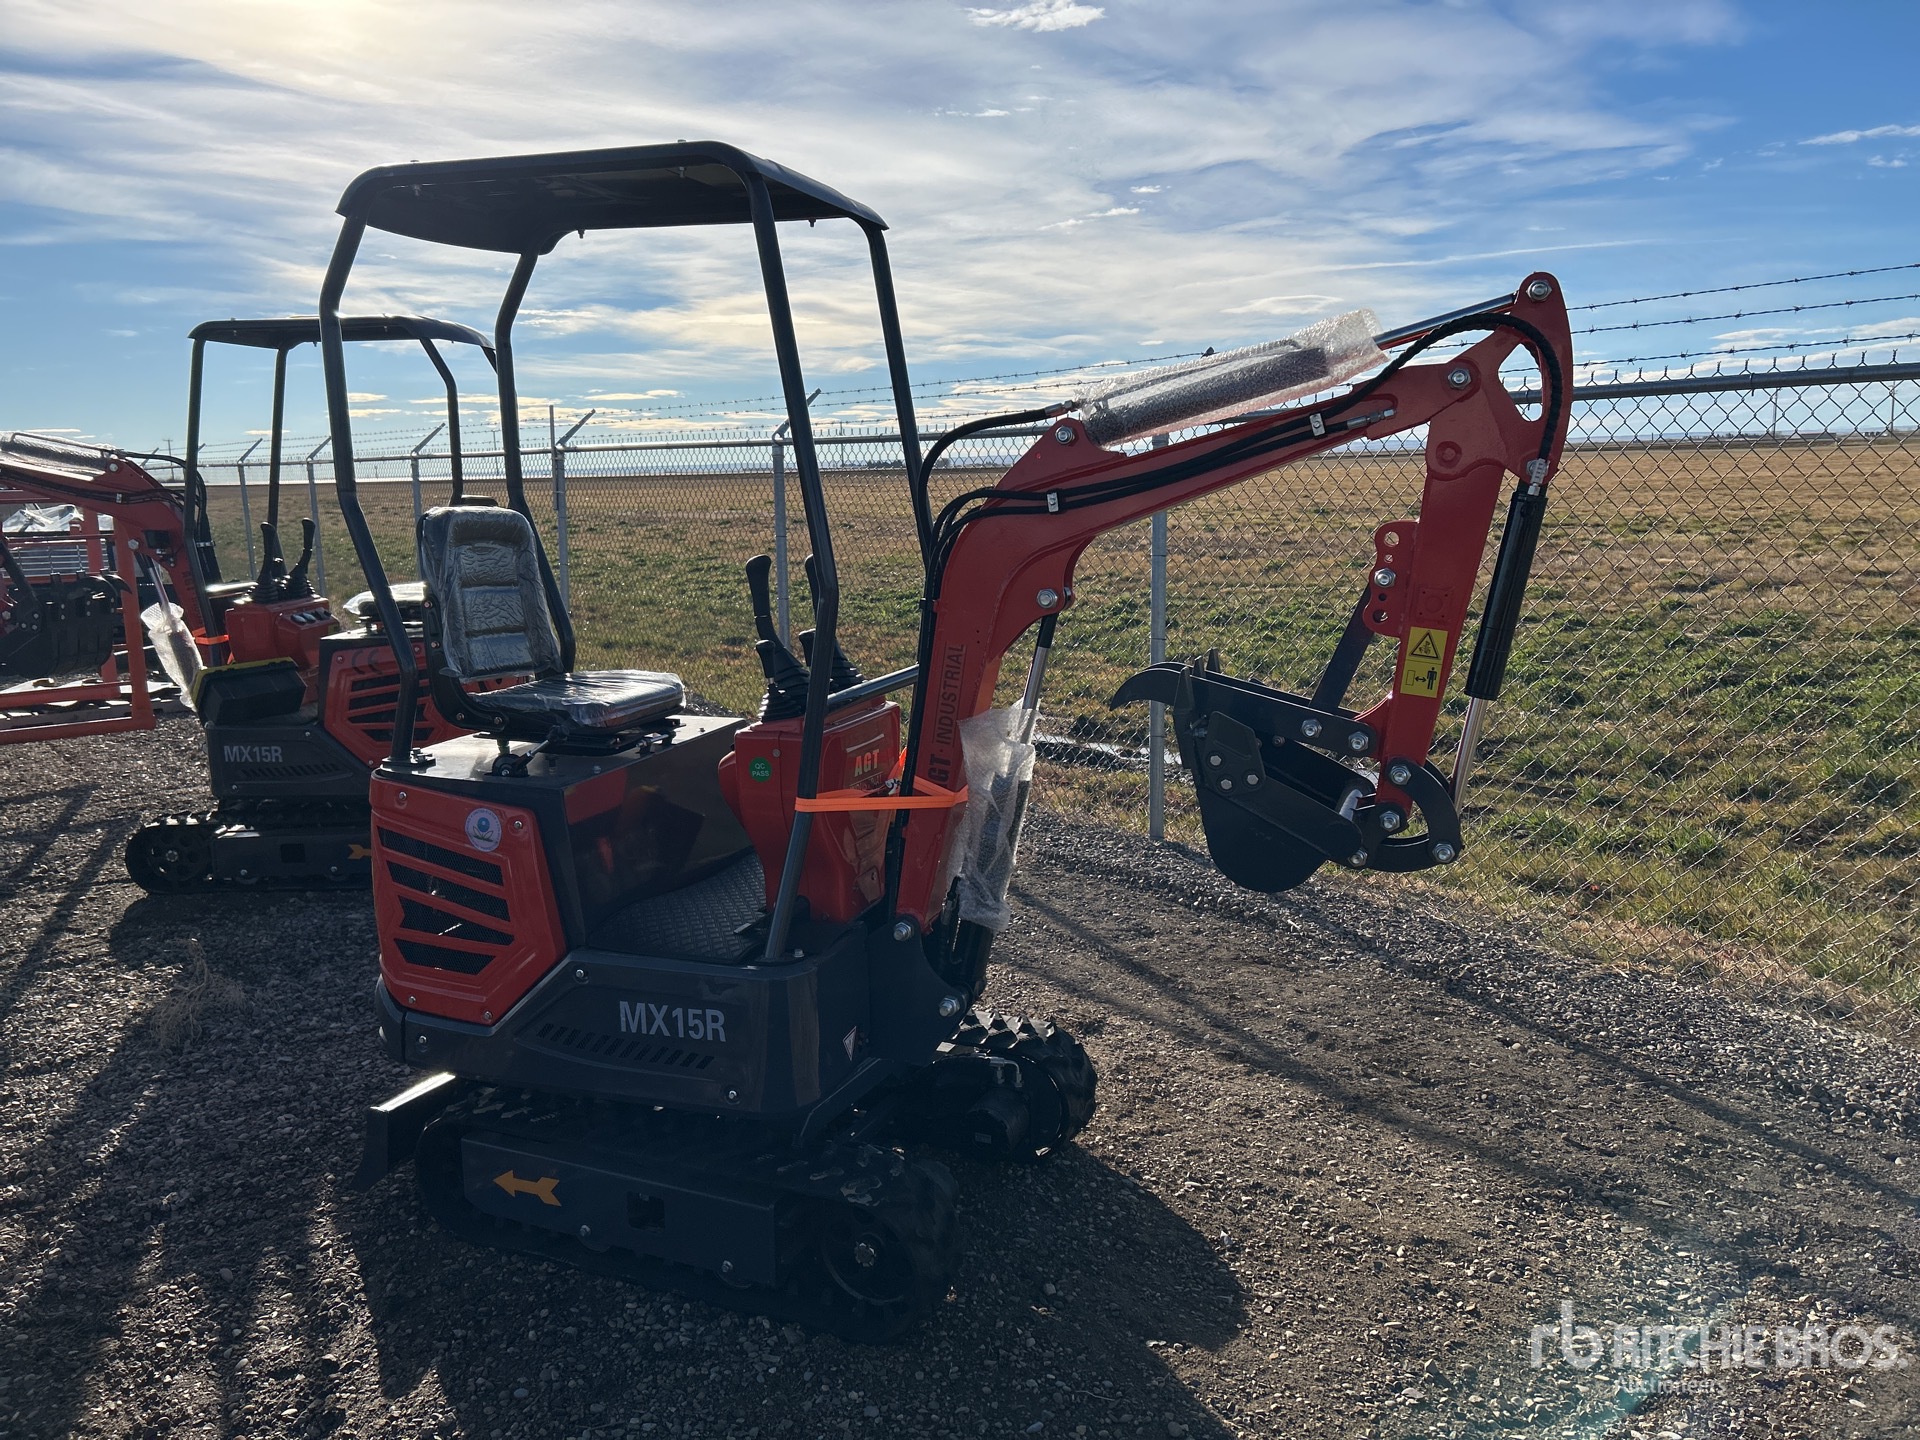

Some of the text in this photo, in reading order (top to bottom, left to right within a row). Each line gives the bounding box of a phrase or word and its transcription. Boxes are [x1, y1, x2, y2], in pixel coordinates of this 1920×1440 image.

[927, 643, 965, 788] GT INDUSTRIAL
[223, 745, 284, 763] MX15R
[754, 762, 766, 770] QC
[854, 748, 880, 778] AGT
[619, 1000, 727, 1042] MX15R
